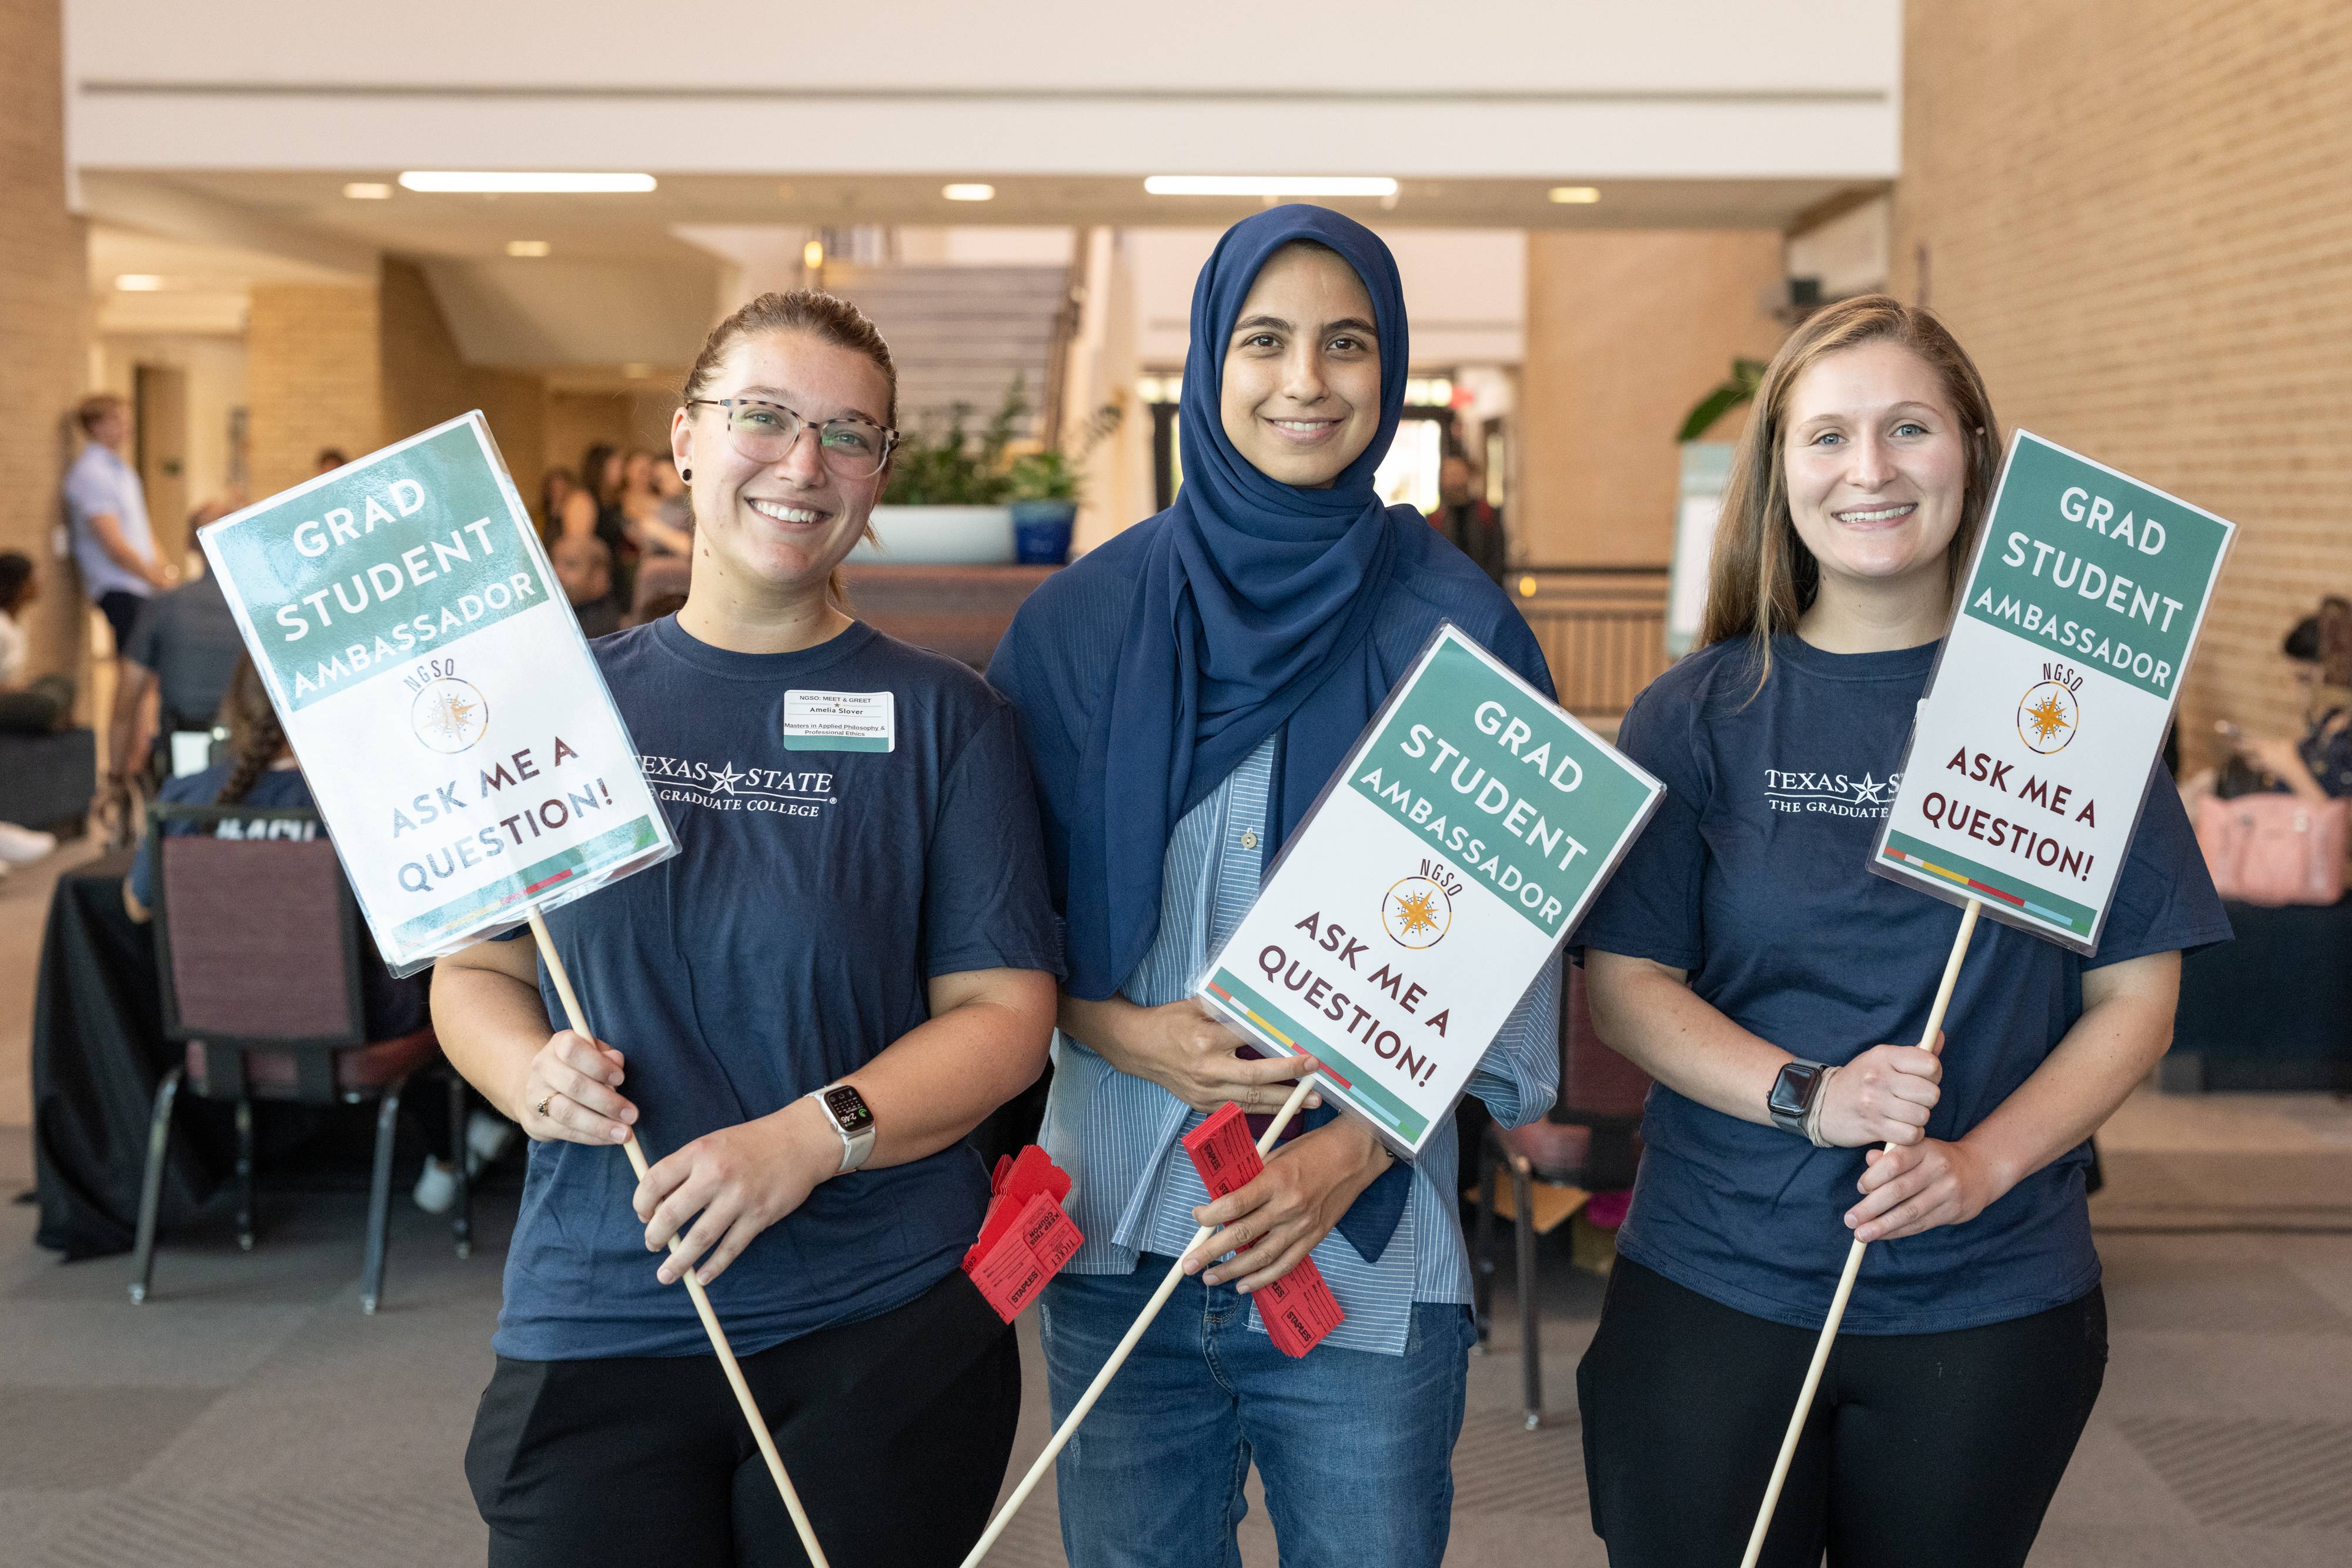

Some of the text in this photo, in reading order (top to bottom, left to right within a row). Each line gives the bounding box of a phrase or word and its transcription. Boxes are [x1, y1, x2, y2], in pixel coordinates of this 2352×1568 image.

[293, 478, 426, 558] GRAD
[2060, 487, 2166, 555] GRAD
[276, 517, 496, 641] STUDENT
[2002, 532, 2183, 633] STUDENT
[295, 573, 536, 699] AMBASSADOR
[1974, 587, 2171, 688] AMBASSADOR
[403, 658, 455, 693] NGSO
[2043, 663, 2083, 692] NGSO
[1475, 701, 1583, 793] GRAD
[392, 736, 579, 838] ASK ME A
[660, 789, 741, 810] GRADUATE
[747, 799, 820, 817] COLLEGE
[746, 768, 833, 793] STATE
[1401, 724, 1588, 872] STUDENT
[1765, 769, 1848, 793] TEXAS
[1947, 746, 2014, 793] ASK
[2019, 775, 2073, 815] ME
[2076, 799, 2096, 828] A
[397, 778, 613, 892] QUESTION!
[1769, 800, 1890, 818] THE GRADUATE
[1360, 767, 1562, 924] AMBASSADOR
[1922, 792, 2094, 882] QUESTION!
[1421, 858, 1463, 897] NGSO
[1295, 911, 1449, 1038] ASK ME A
[1258, 945, 1438, 1088] QUESTION!
[841, 1112, 856, 1123] 2:46
[1204, 1143, 1221, 1171] STAPLES
[1030, 1211, 1053, 1238] COUPON
[1030, 1231, 1044, 1246] THIS
[1044, 1212, 1060, 1231] KEEP
[1051, 1239, 1075, 1267] TICKET
[1011, 1271, 1038, 1303] STAPLES
[1287, 1311, 1312, 1342] STAPLES
